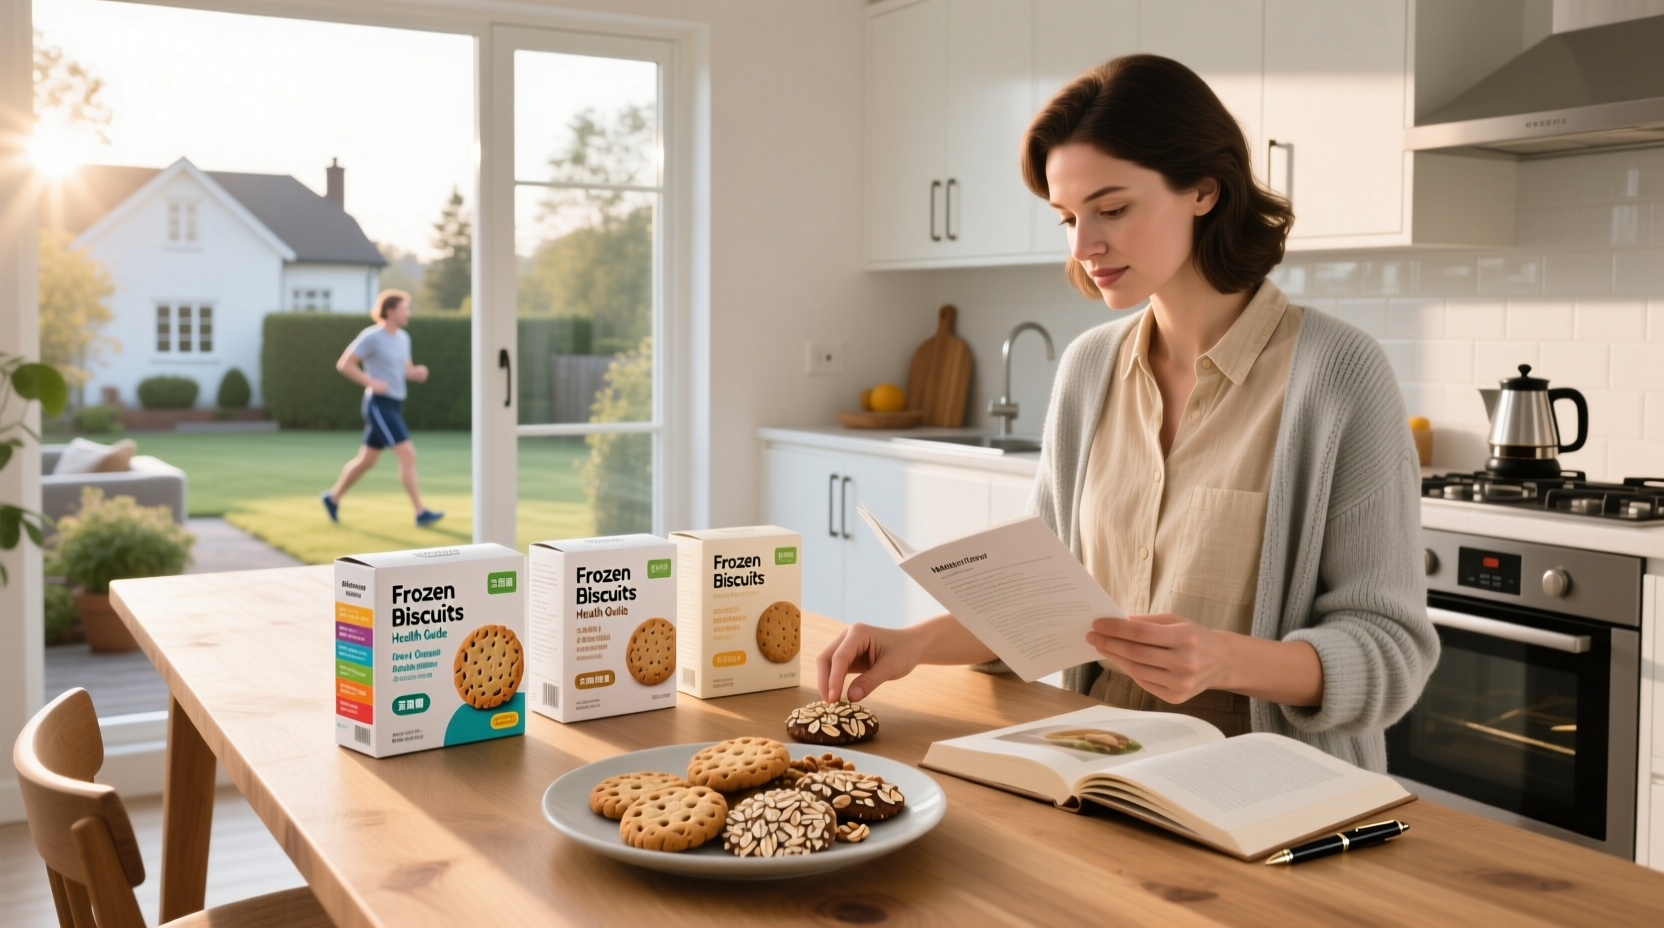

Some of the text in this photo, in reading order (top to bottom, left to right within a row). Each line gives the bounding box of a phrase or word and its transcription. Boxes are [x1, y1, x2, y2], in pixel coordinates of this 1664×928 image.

[714, 555, 761, 570] Frozen
[576, 567, 631, 584] Frozen
[714, 571, 765, 588] Biscuits
[392, 585, 455, 604] Frozen
[576, 585, 637, 605] Biscuits
[392, 604, 464, 627] Biscuits
